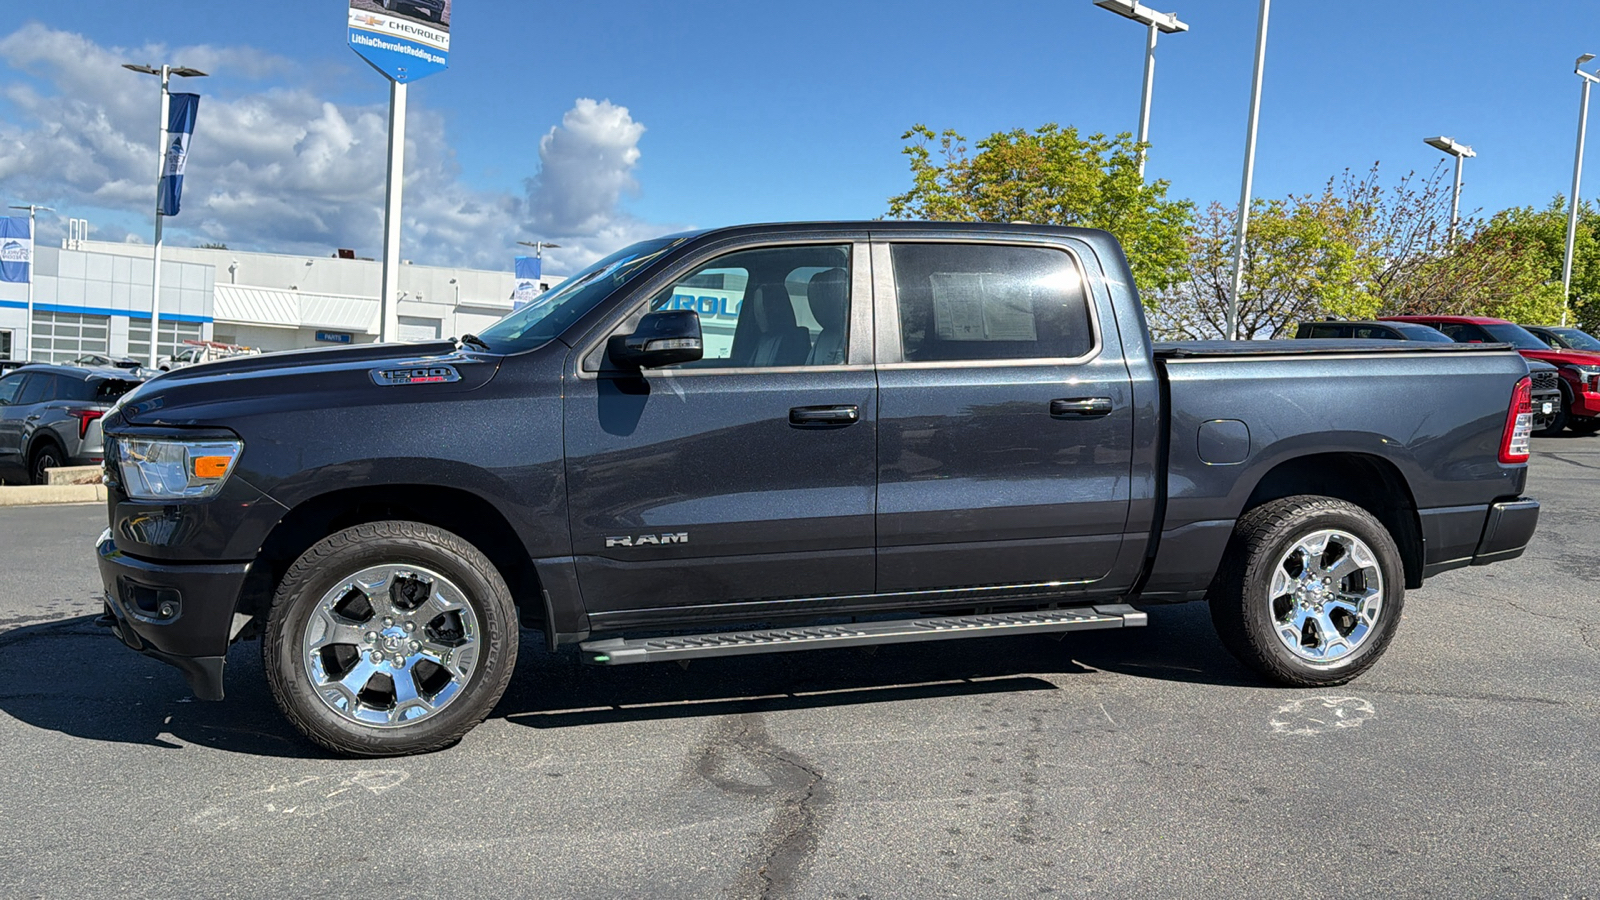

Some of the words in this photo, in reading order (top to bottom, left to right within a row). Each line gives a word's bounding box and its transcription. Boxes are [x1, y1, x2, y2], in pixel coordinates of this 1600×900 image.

[389, 21, 446, 43] CHEVROLET
[351, 33, 446, 65] LithiaChevroletRedding.com
[324, 333, 342, 342] PARTS
[605, 532, 688, 547] RAM
